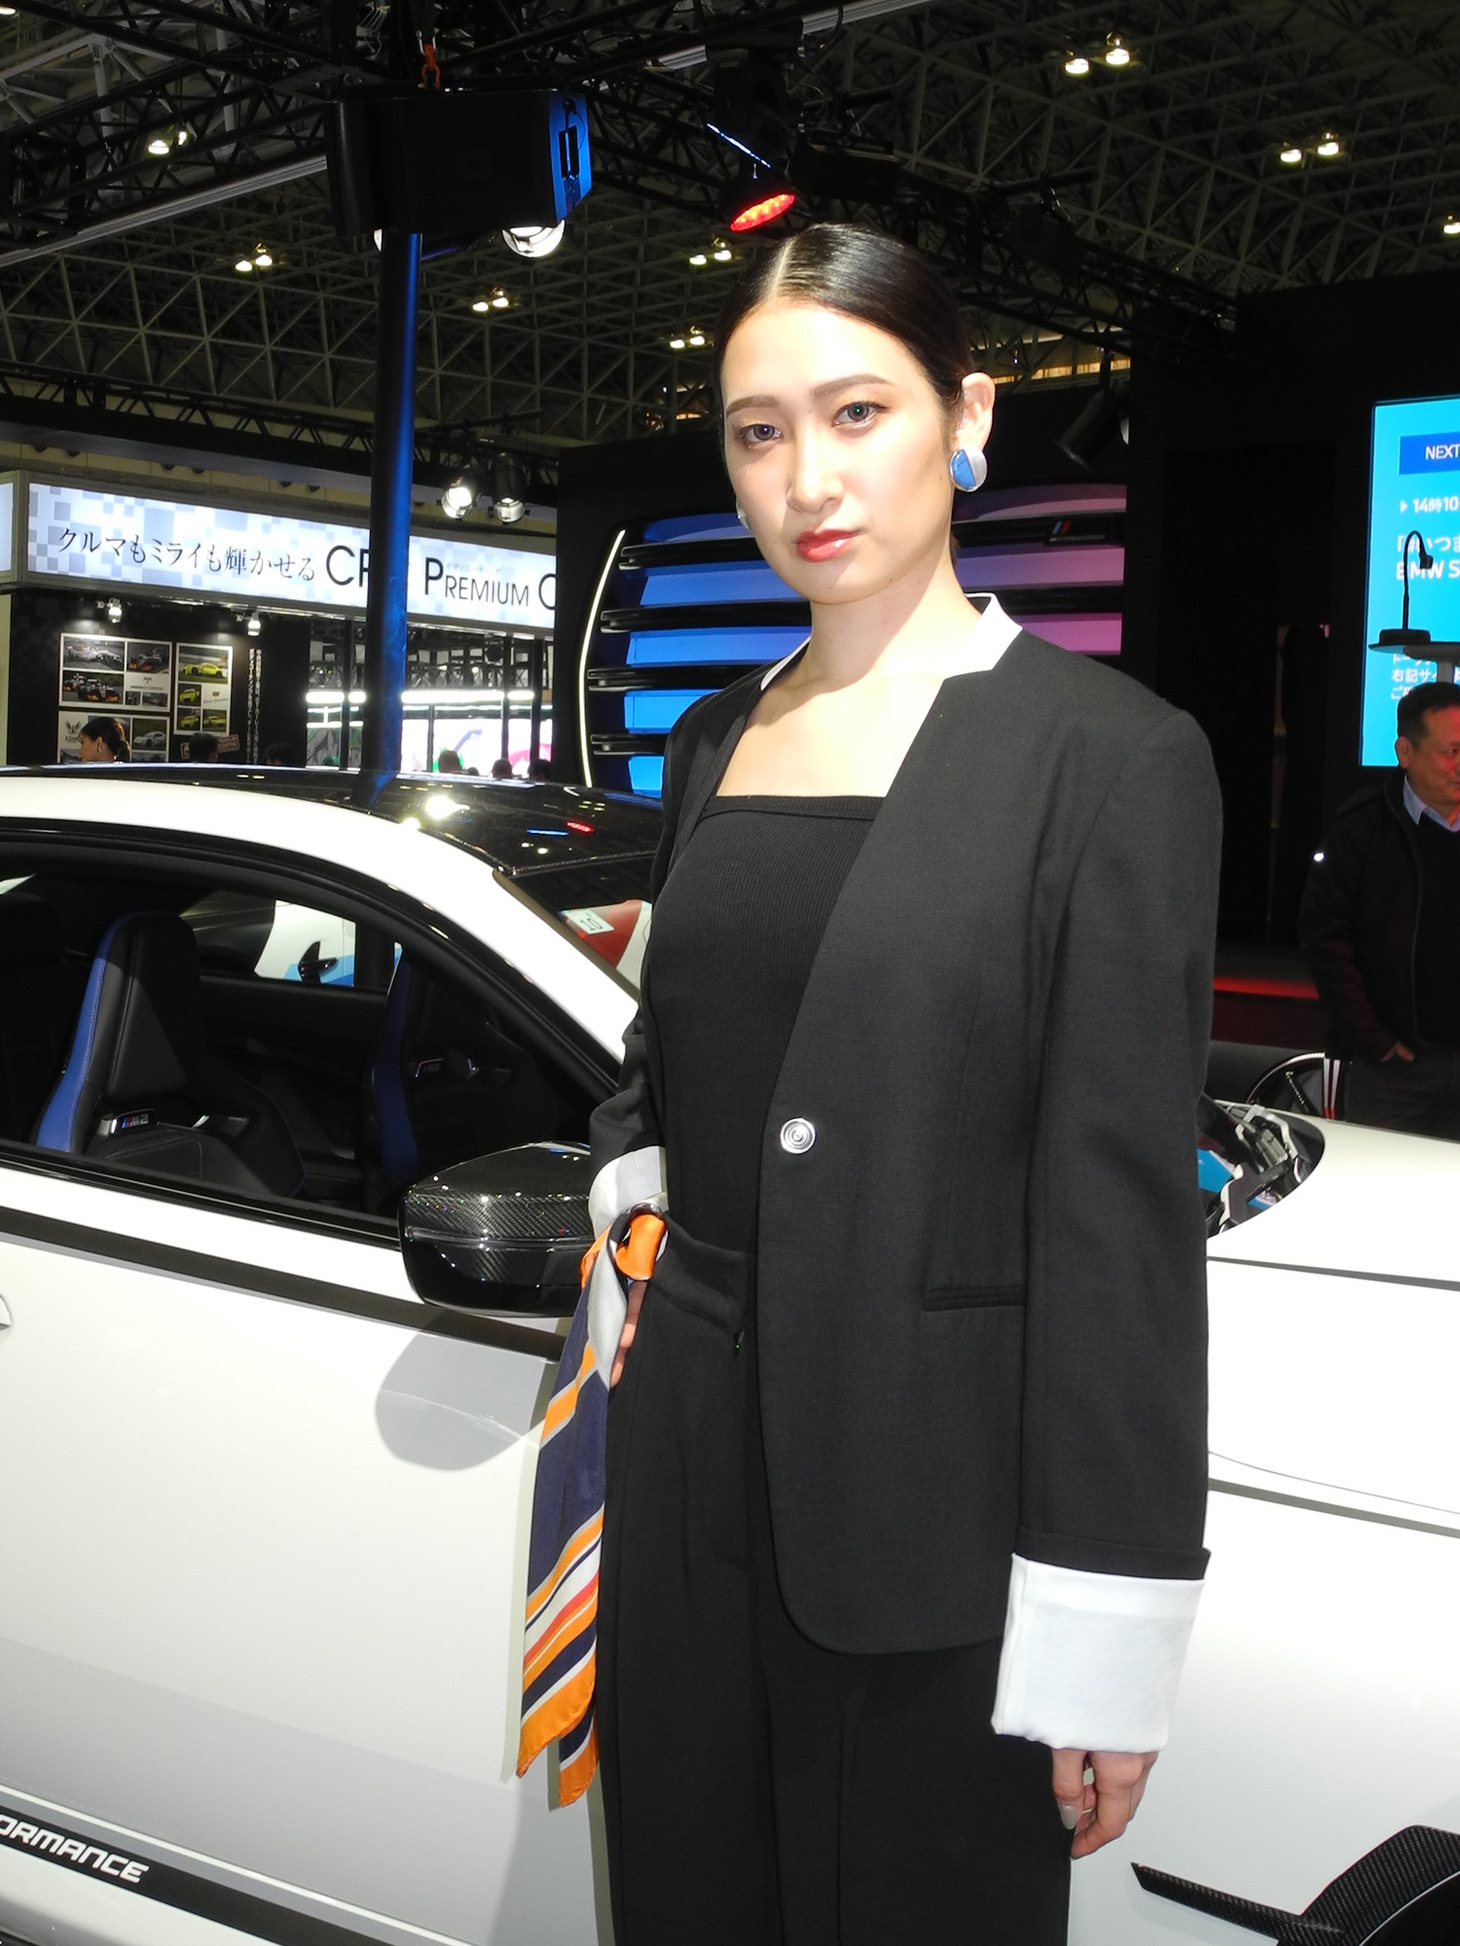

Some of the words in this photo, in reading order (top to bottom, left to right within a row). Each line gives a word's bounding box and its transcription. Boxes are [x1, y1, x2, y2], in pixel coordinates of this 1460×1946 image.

[1425, 443, 1460, 460] NEXT
[57, 528, 315, 581] クルマもミライも輝かせる
[424, 557, 529, 607] PREMIUM
[0, 1814, 150, 1884] ORMANCE
